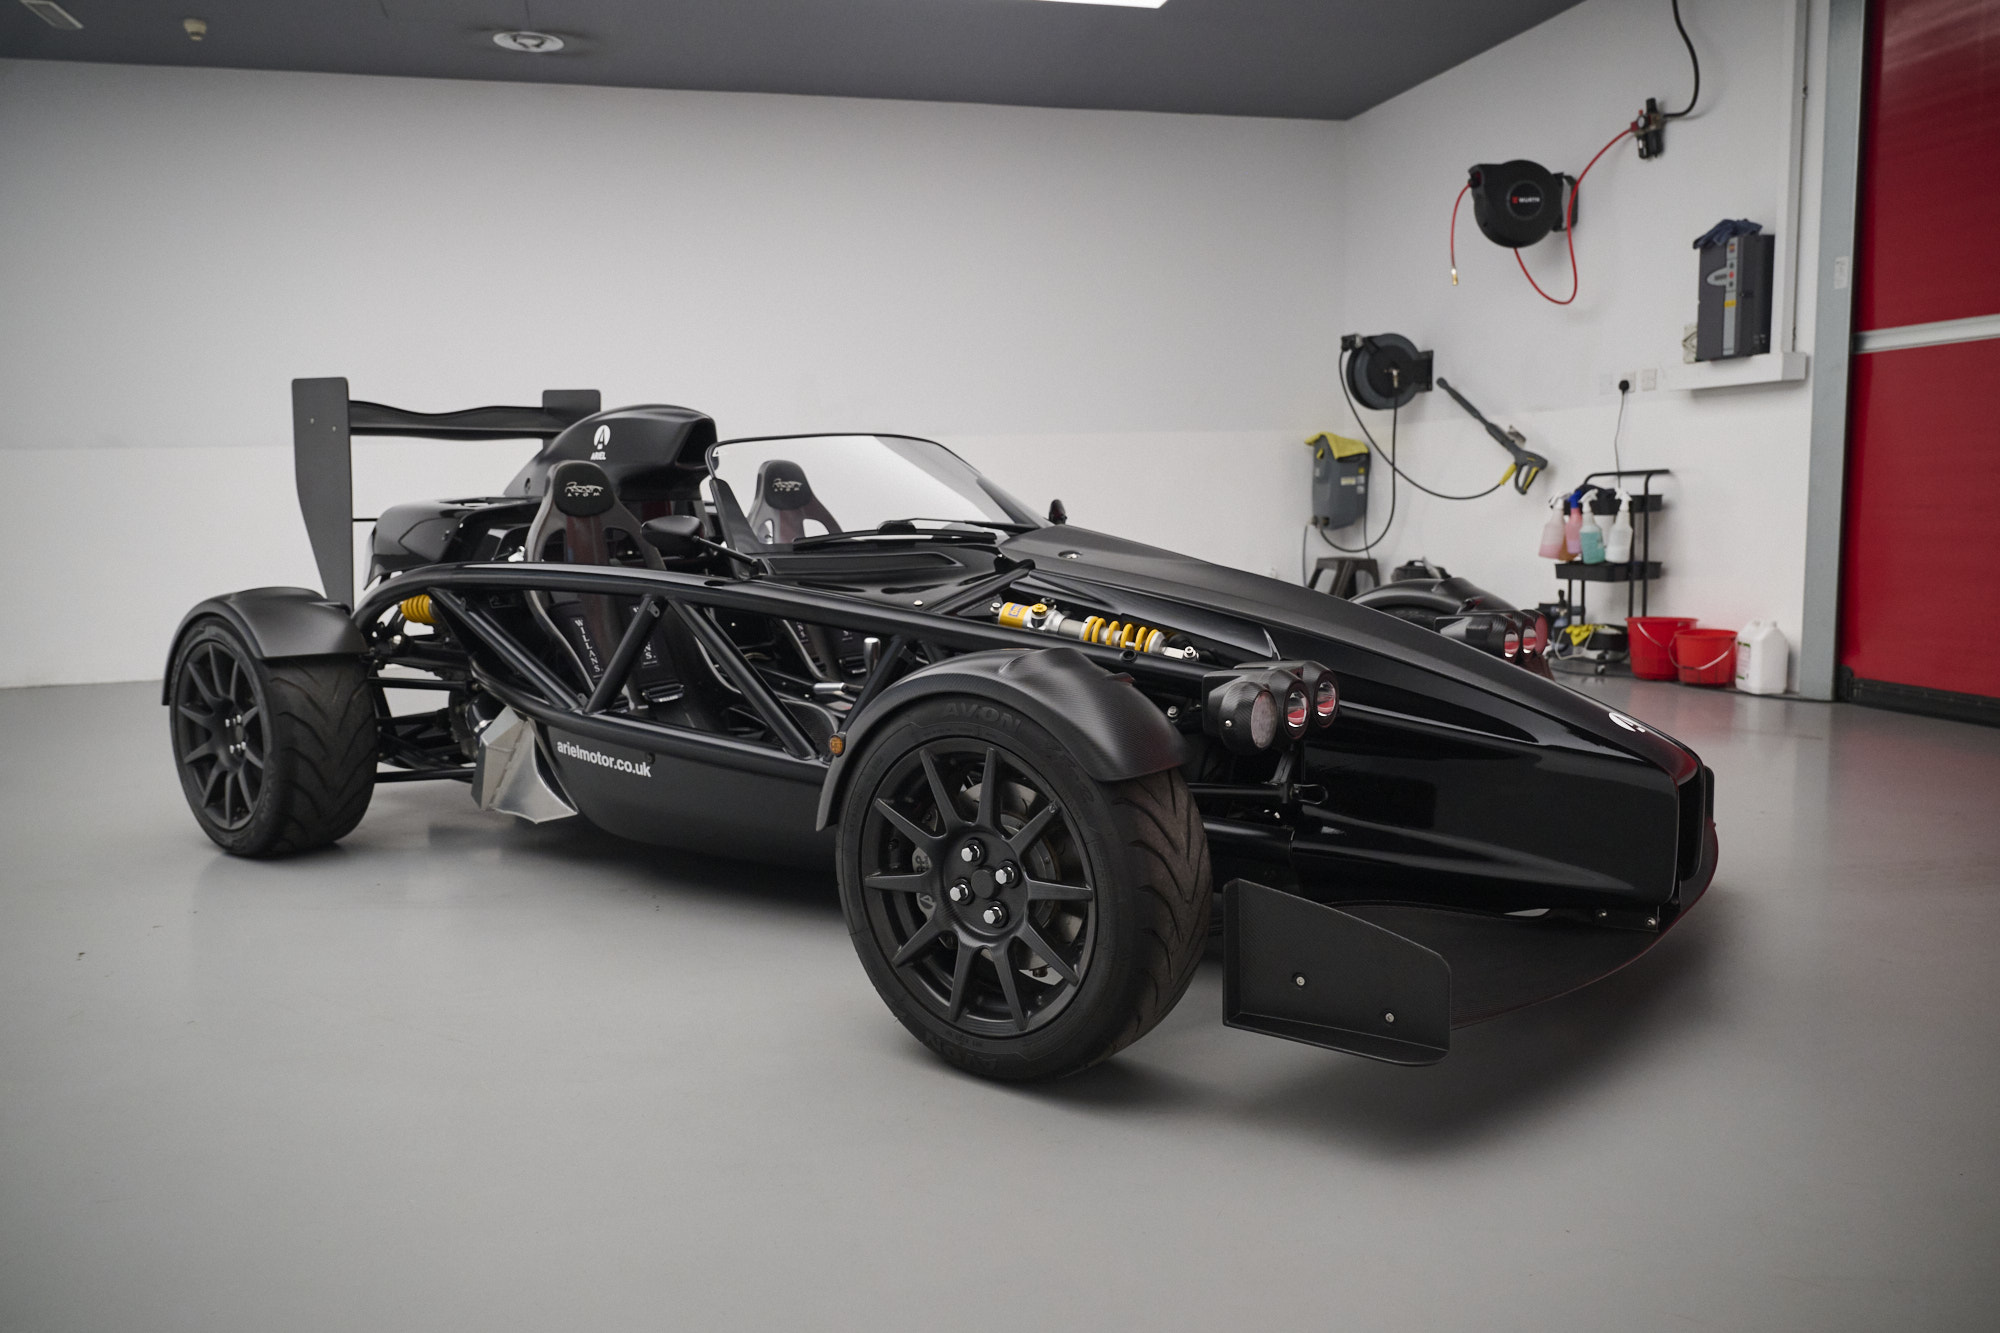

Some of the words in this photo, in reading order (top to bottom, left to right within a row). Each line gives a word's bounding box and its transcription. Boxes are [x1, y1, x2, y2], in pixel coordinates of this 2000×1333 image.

[590, 451, 607, 461] ARIEL
[574, 618, 602, 673] WILLANS
[943, 702, 1023, 731] AVON
[557, 740, 652, 778] arielmotor.co.uk
